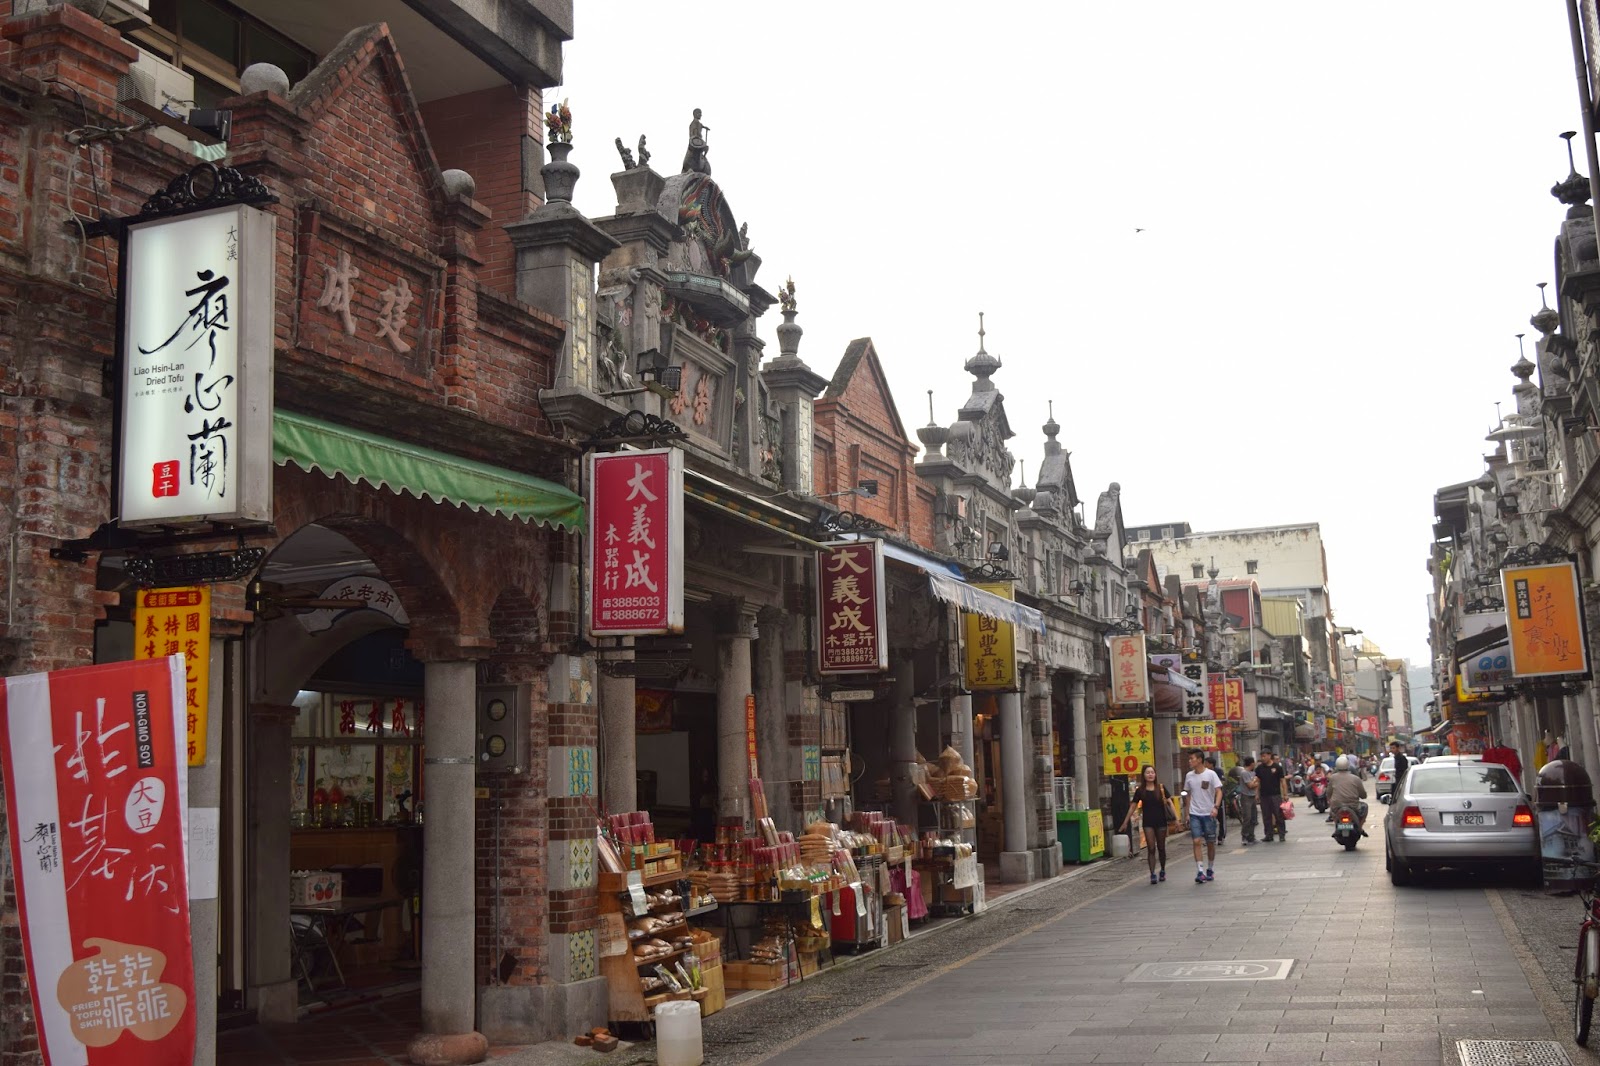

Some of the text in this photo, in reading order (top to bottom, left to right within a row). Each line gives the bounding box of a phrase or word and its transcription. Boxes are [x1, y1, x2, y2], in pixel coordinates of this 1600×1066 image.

[225, 224, 238, 262] 大溪
[133, 362, 185, 376] Liao Hsin-Lan
[146, 373, 184, 386] Dried Tofu
[137, 269, 235, 500] 廖心蘭
[159, 463, 174, 496] 豆干
[624, 461, 659, 593] 大義成
[603, 523, 621, 591] 木器行
[827, 549, 871, 631] 大義成
[826, 632, 875, 648] 木器行
[1118, 639, 1140, 699] 再生堂
[136, 693, 151, 766] NON-GMO SOY
[1106, 724, 1149, 740] 冬瓜茶
[1106, 741, 1150, 755] 仙草茶
[1112, 755, 1138, 773] 10
[132, 781, 157, 831] 大豆
[72, 1000, 101, 1012] FRIED
[76, 1009, 102, 1020] TOFU
[80, 1018, 103, 1029] SKIN
